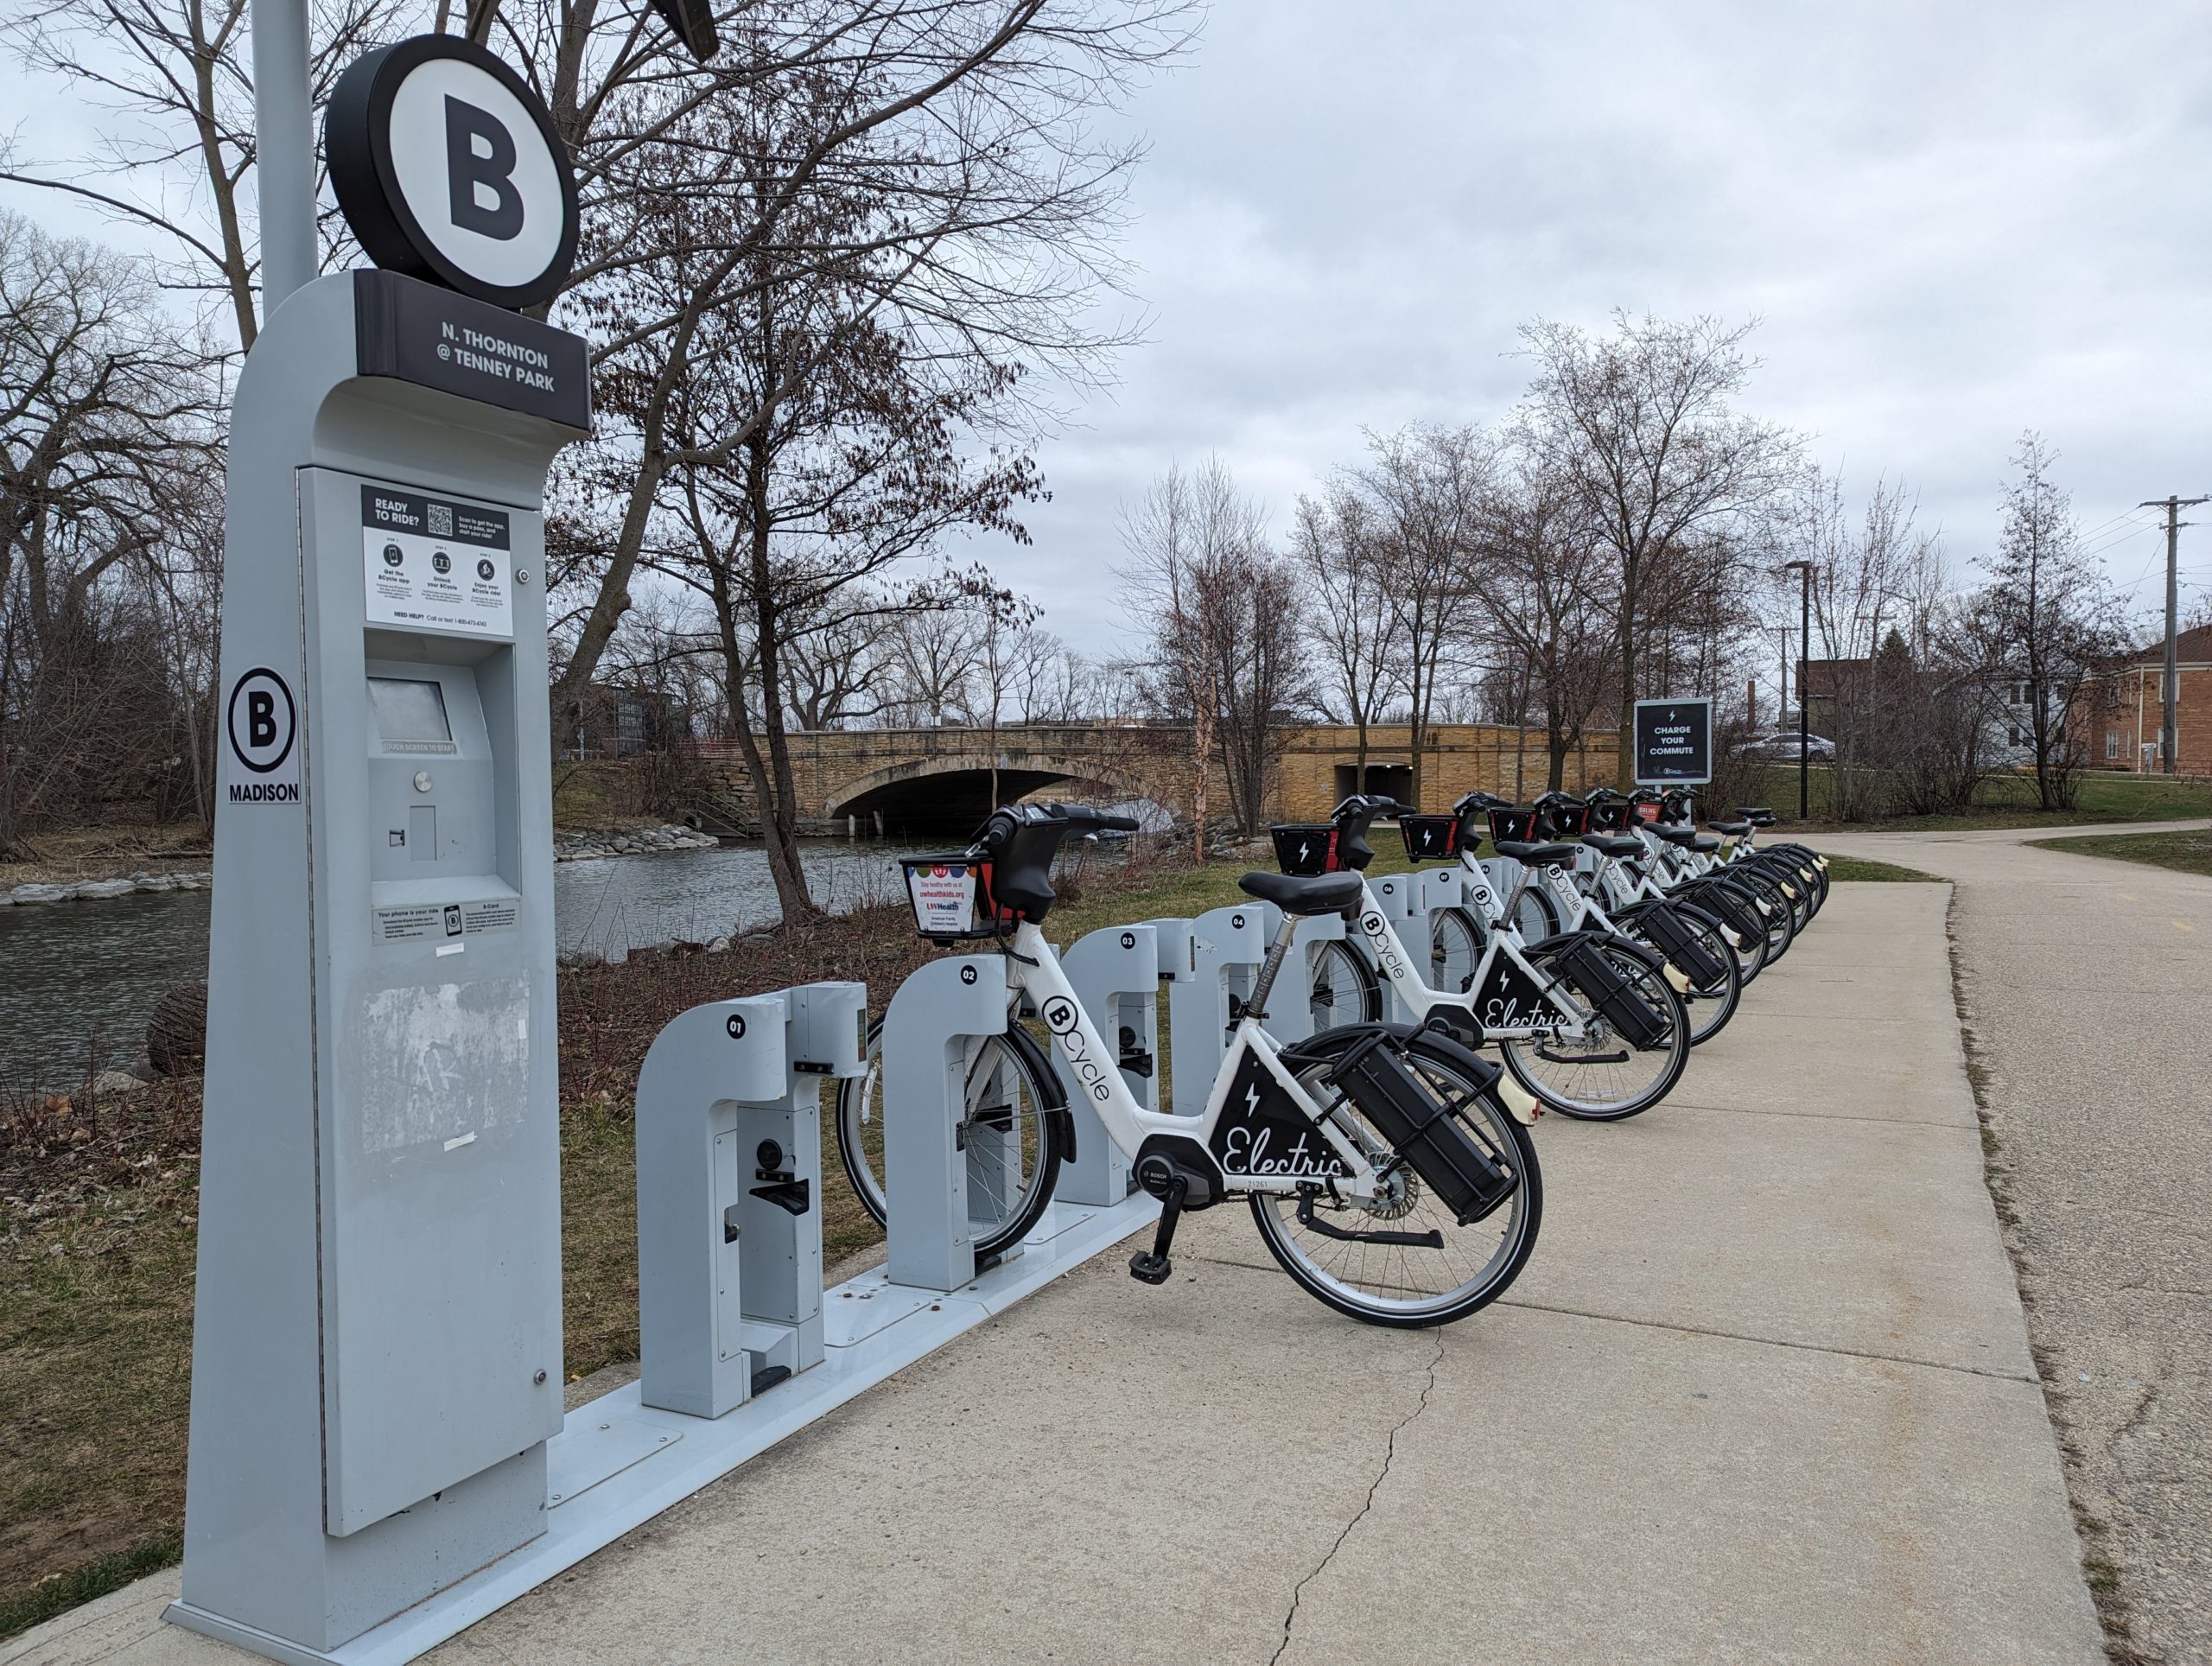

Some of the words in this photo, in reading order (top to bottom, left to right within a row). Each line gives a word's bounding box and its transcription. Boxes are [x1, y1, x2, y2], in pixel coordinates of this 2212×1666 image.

[443, 92, 525, 242] B
[442, 321, 460, 341] N.
[462, 328, 549, 370] THORNTON
[436, 343, 451, 361] @
[454, 347, 512, 379] TENNEY
[515, 366, 556, 392] PARK
[375, 498, 408, 512] READY
[375, 508, 390, 521] TO
[391, 512, 419, 526] RIDE?
[433, 575, 451, 584] Unlock
[474, 582, 487, 590] Enjoy
[248, 690, 277, 747] B
[1654, 726, 1691, 734] CHARGE
[404, 744, 429, 753] SCREEN
[429, 744, 437, 753] TO
[436, 744, 454, 754] START
[1649, 747, 1694, 755] COMMUTE
[229, 783, 299, 802] MADISON
[919, 890, 965, 900] uwhealthkids.org
[1232, 917, 1244, 926] 04
[1122, 937, 1134, 946] 03
[963, 970, 976, 981] 02
[1484, 997, 1568, 1028] Electric
[729, 1020, 742, 1034] 01
[1223, 1126, 1341, 1176] Electric
[1248, 1180, 1268, 1189] 21261
